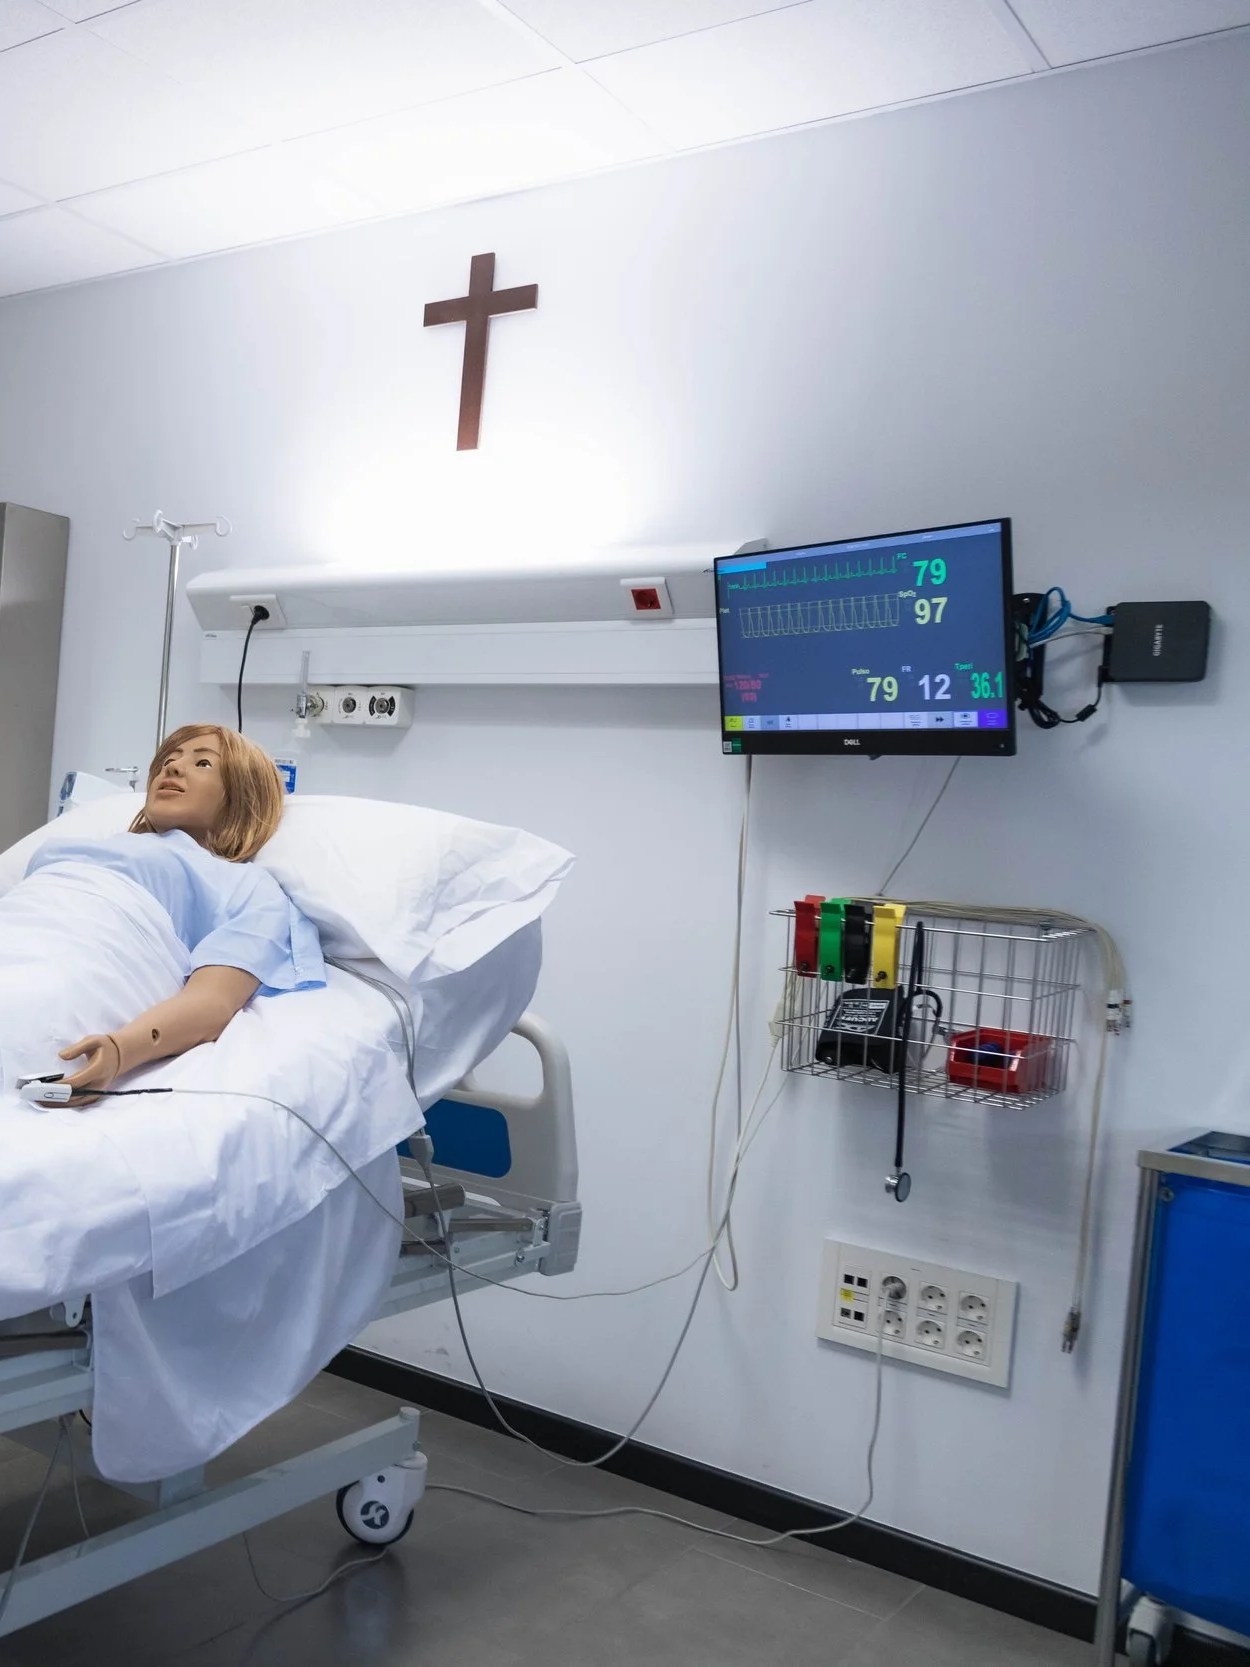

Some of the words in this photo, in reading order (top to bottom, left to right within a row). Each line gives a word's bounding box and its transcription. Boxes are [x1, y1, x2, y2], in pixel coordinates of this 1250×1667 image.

[912, 558, 948, 587] 79
[914, 596, 948, 625] 97
[901, 665, 912, 673] FR
[866, 675, 899, 702] 79
[917, 673, 952, 701] 12
[970, 671, 1004, 699] 36.1
[844, 738, 861, 746] DELL
